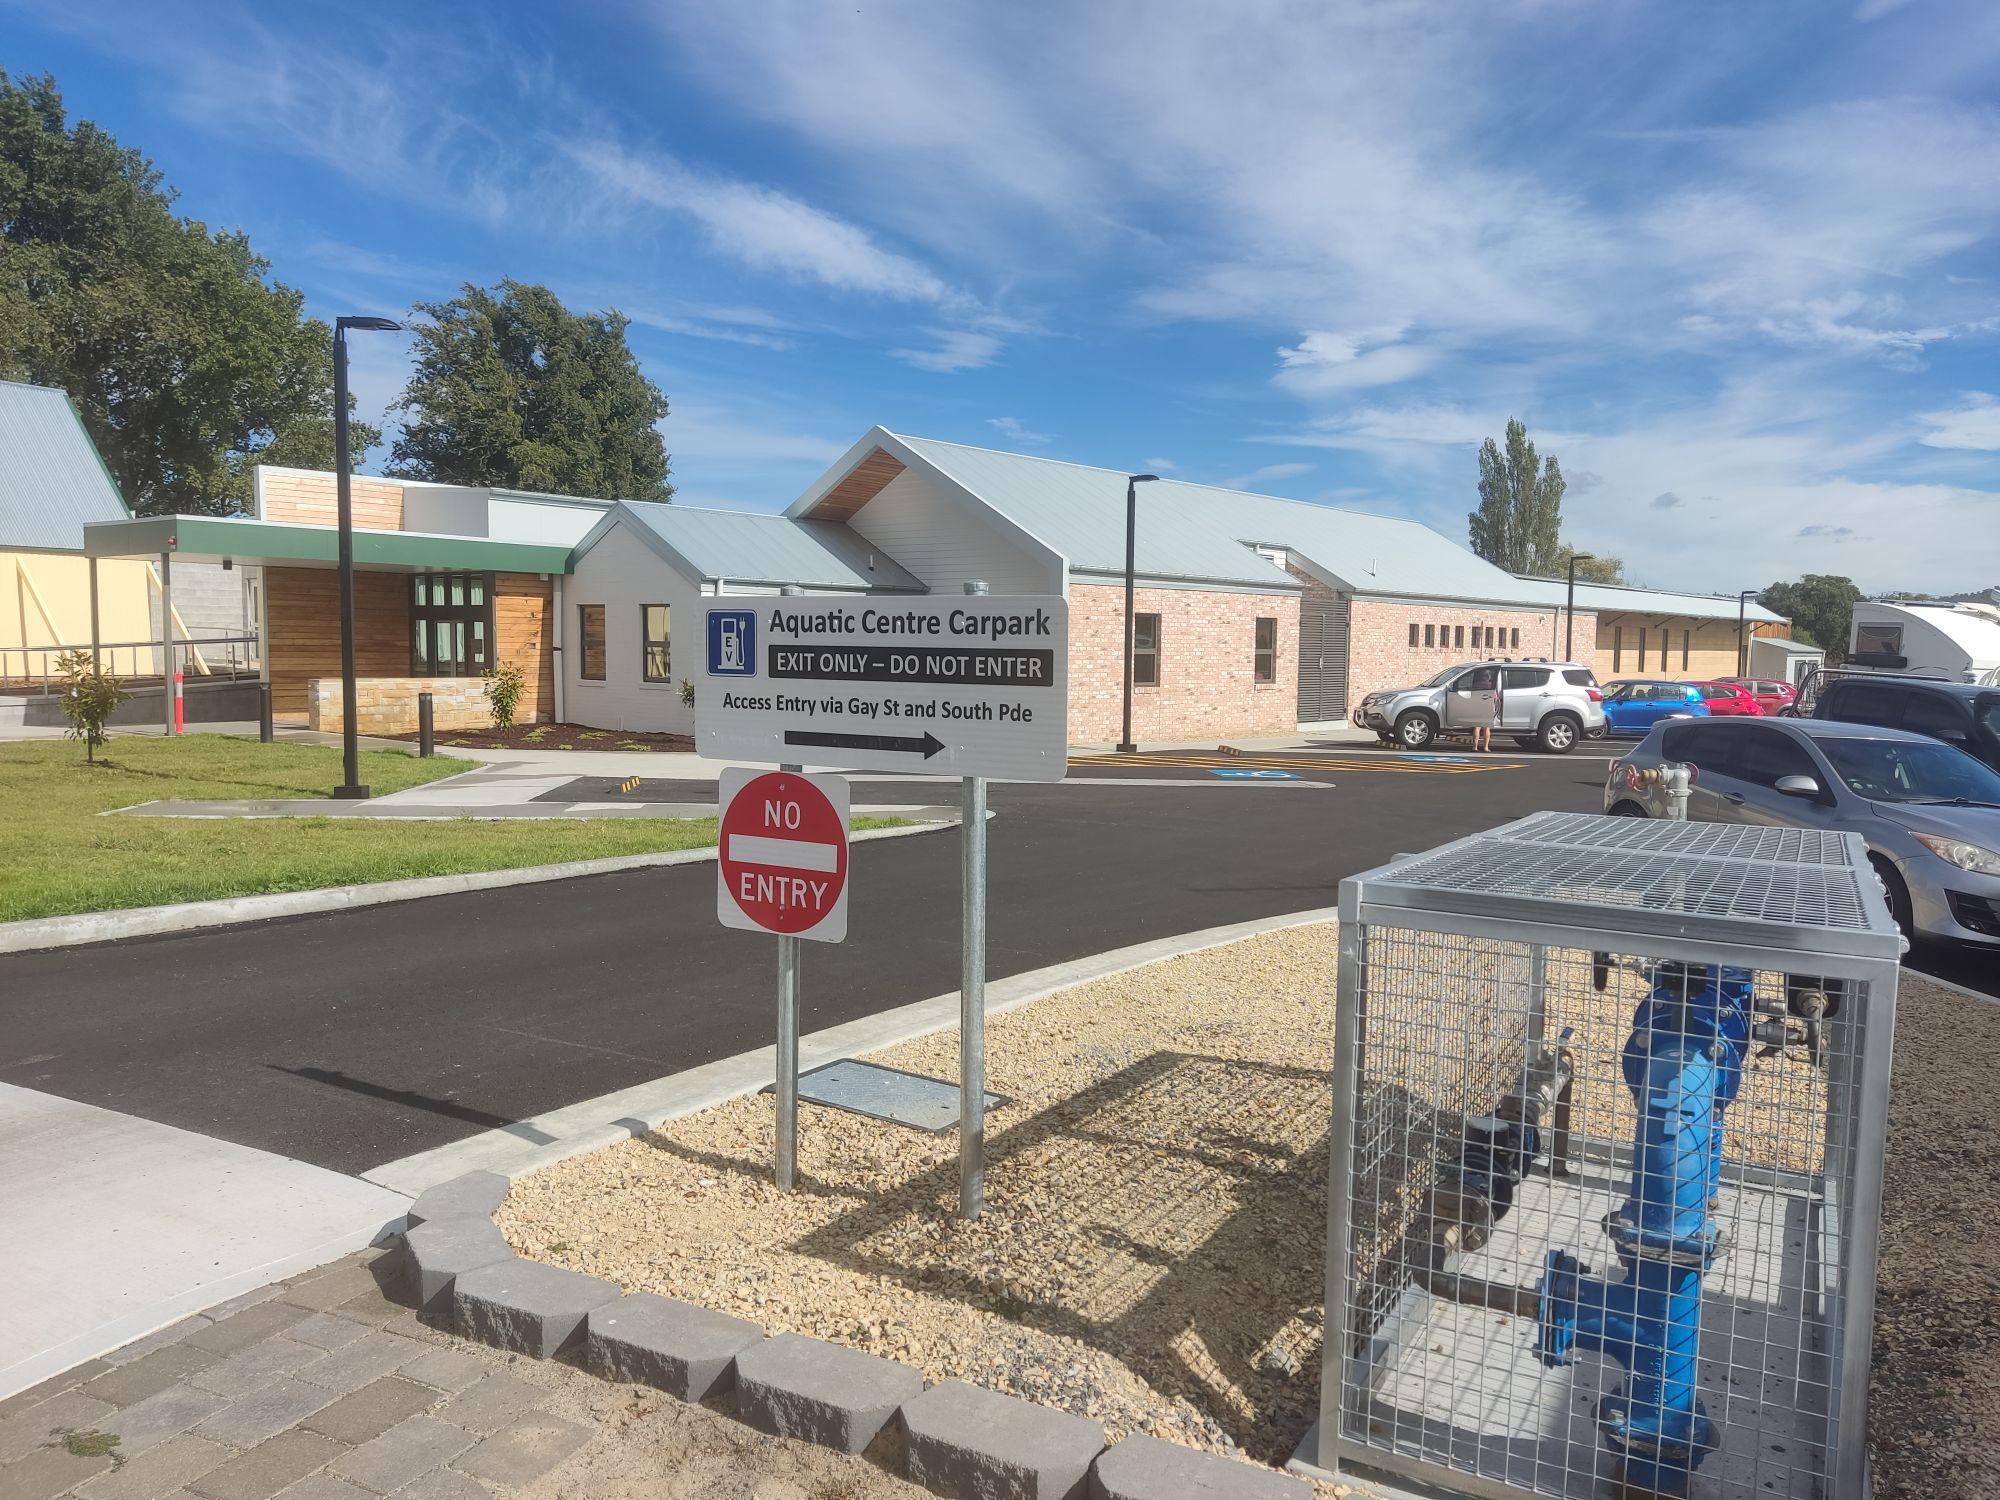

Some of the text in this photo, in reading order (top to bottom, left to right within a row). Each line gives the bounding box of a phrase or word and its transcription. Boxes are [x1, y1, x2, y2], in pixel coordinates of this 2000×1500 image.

[769, 608, 1051, 641] Aquatic Centre Carpark
[725, 636, 733, 662] EV
[776, 652, 814, 672] EXIT
[819, 653, 868, 673] ONLY
[890, 655, 920, 675] DO
[926, 655, 969, 676] NOT
[975, 656, 1042, 678] ENTER
[722, 692, 1033, 722] Access Entry via Gay St and South Pde
[764, 799, 801, 830] NO
[740, 872, 828, 911] ENTRY
